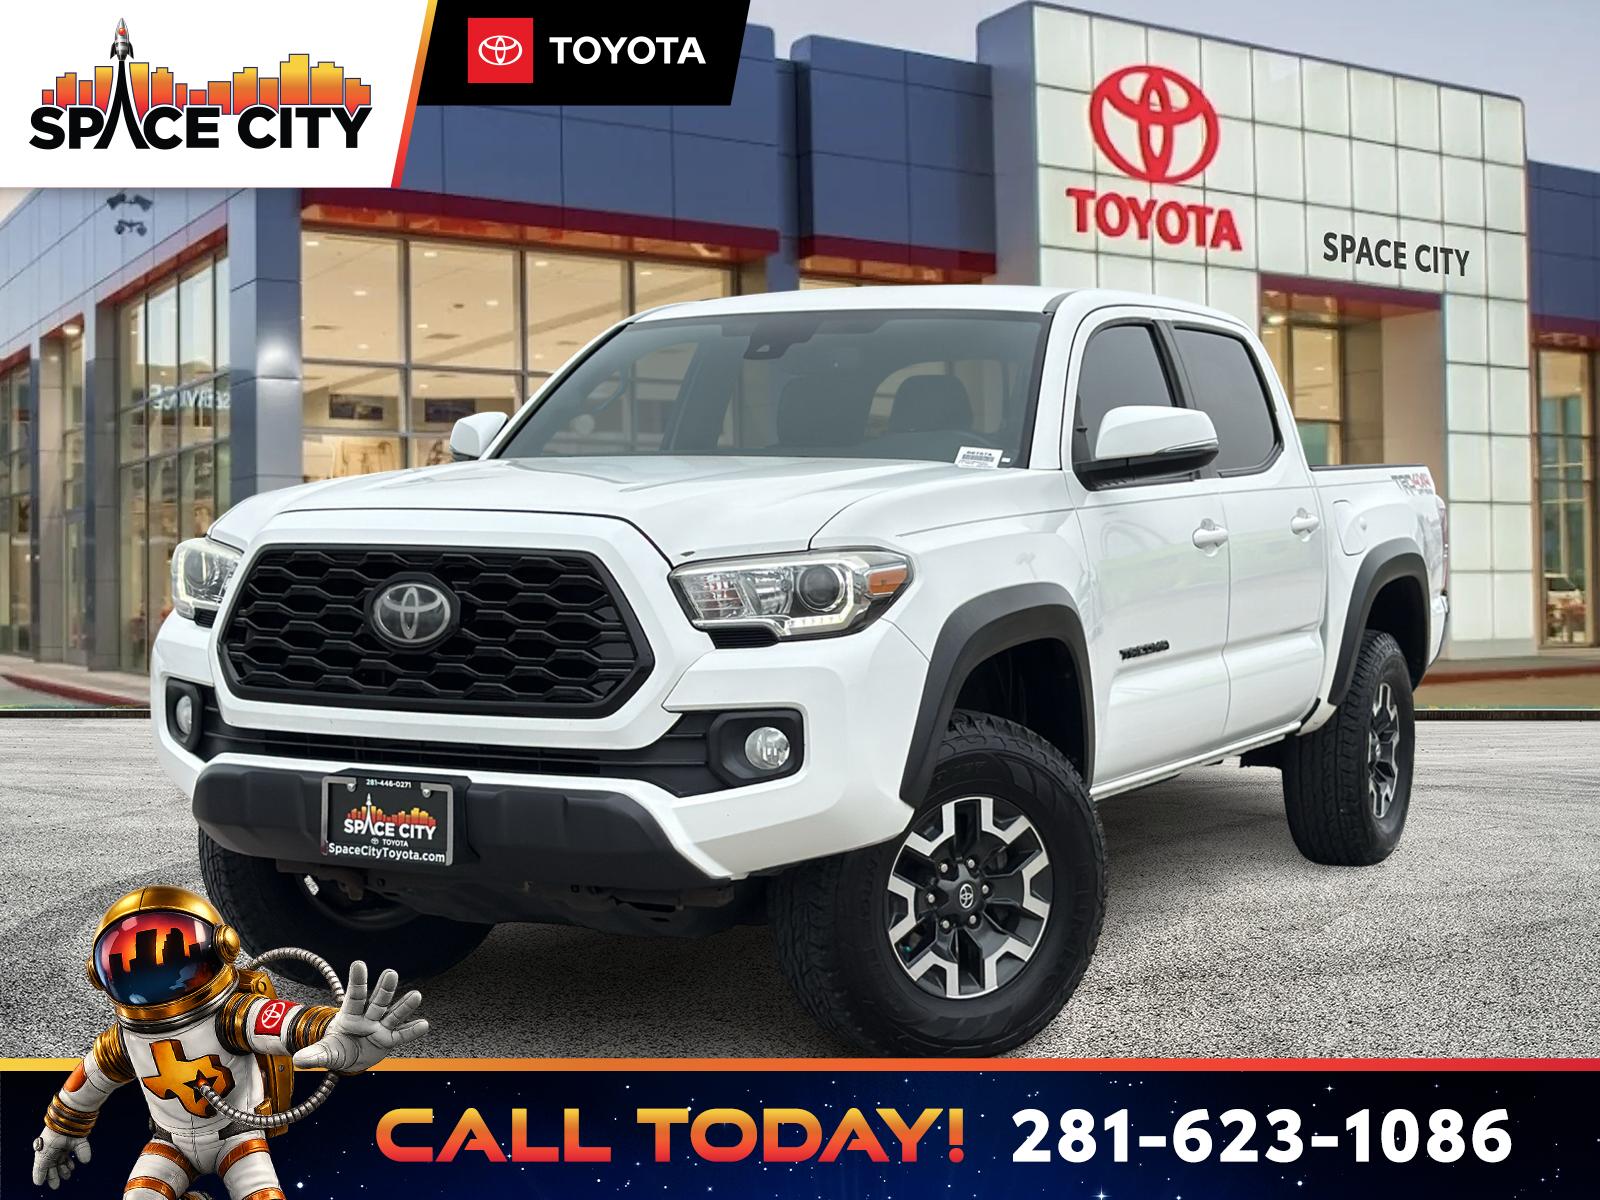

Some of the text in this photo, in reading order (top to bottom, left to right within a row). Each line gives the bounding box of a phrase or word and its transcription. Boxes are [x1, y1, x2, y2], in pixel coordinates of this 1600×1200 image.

[1066, 187, 1242, 251] TOYOTA
[1323, 232, 1470, 277] SPACE CITY
[343, 818, 436, 840] SPACE CITY
[328, 842, 446, 863] SpaceCityToyota.com
[382, 838, 409, 847] TOYOTA
